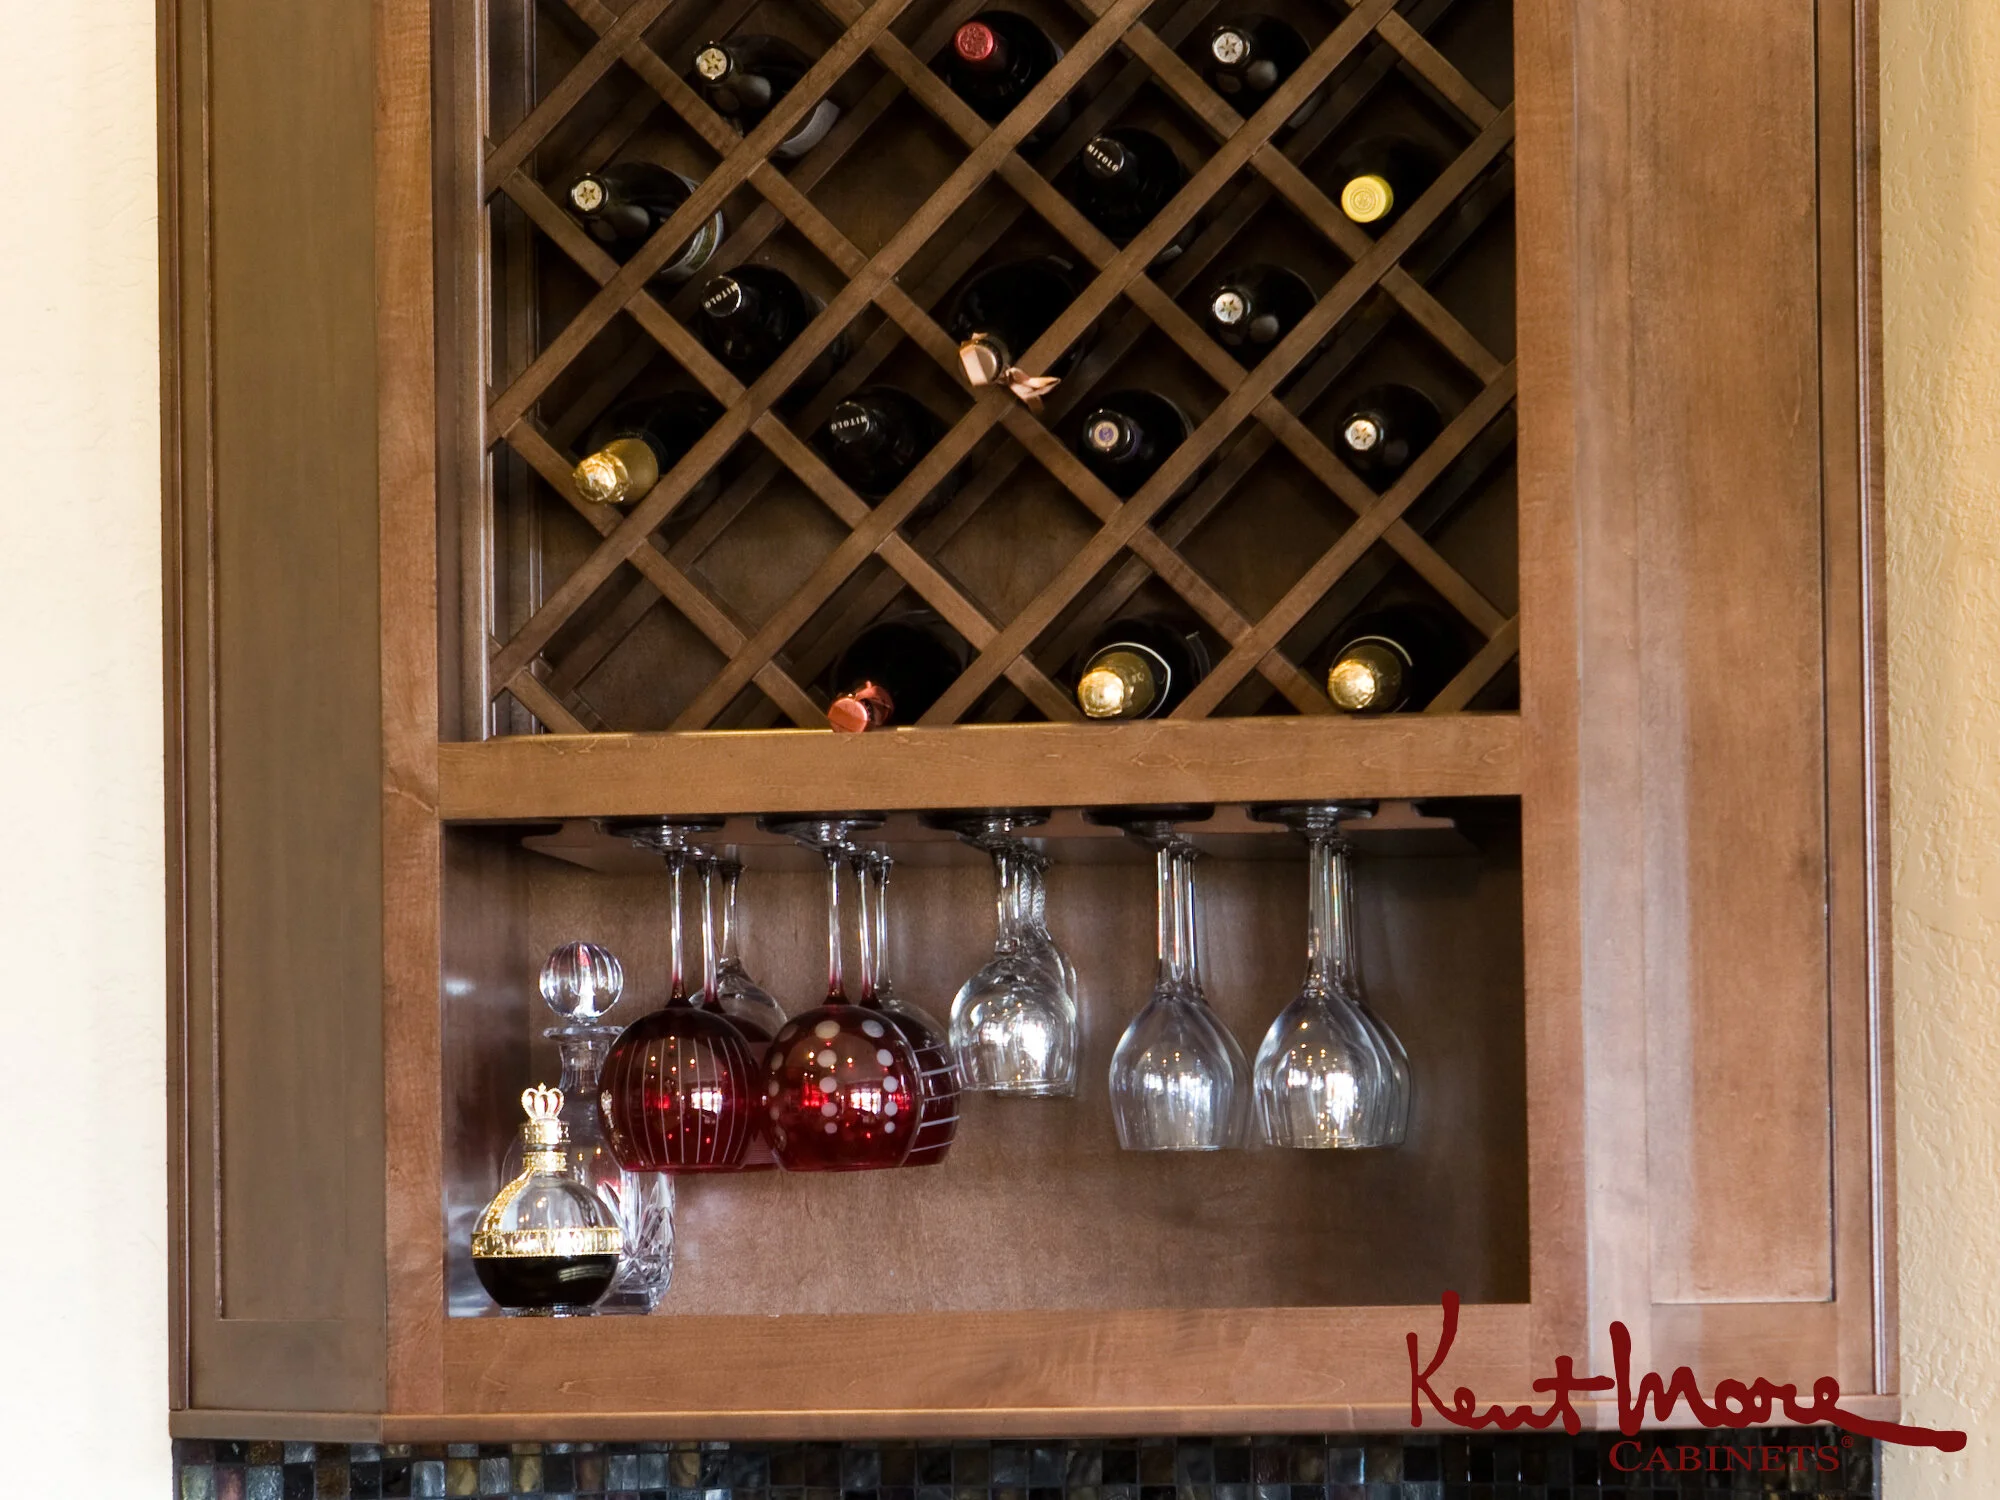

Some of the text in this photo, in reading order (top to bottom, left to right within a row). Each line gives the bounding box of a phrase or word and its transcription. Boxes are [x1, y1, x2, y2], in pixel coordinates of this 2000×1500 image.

[1086, 144, 1120, 172] MITOLO
[704, 281, 740, 309] MITOLO
[830, 415, 868, 431] MITOLO
